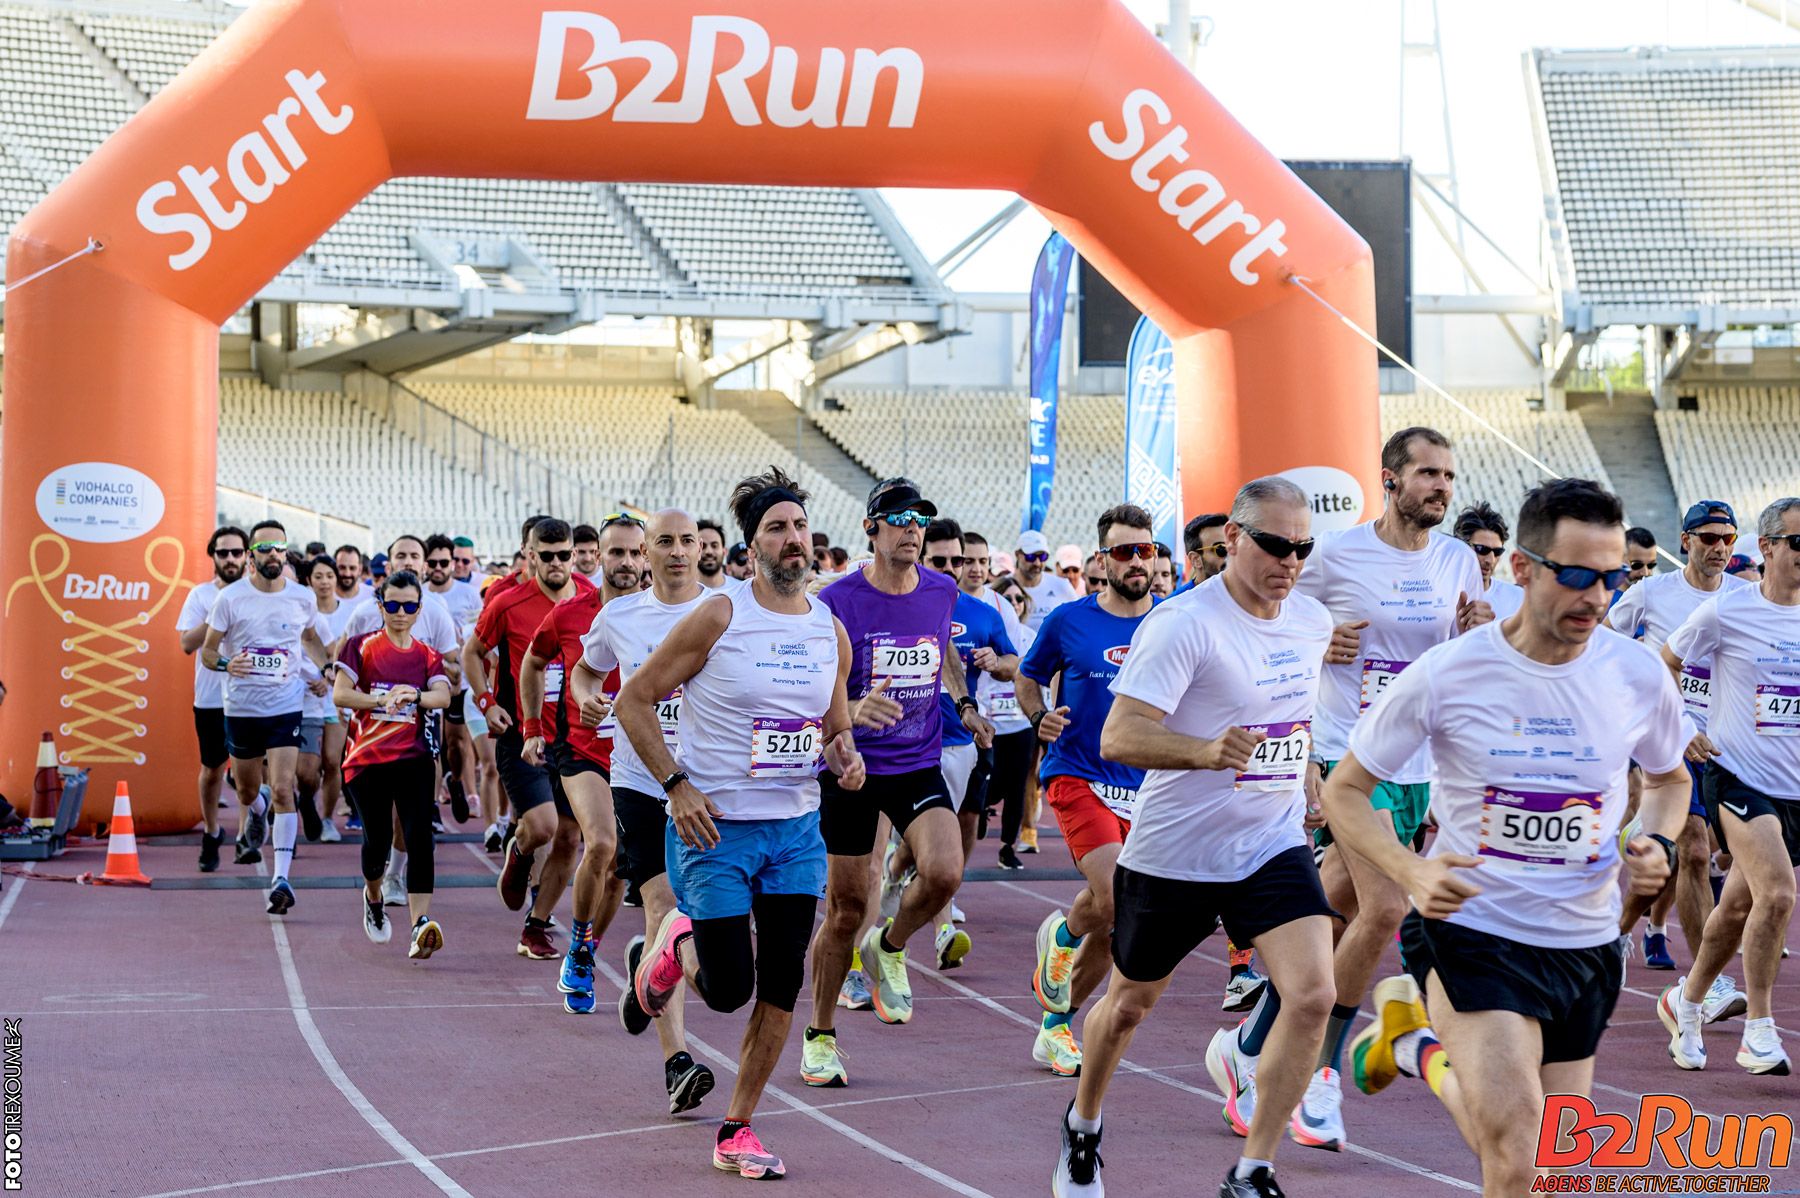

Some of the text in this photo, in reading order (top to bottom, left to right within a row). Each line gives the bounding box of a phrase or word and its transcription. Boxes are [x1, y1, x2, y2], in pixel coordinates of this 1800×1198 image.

[526, 10, 923, 129] B2Run
[135, 68, 354, 271] Start
[1088, 88, 1288, 286] Start
[456, 241, 478, 262] 34
[74, 481, 134, 494] VIOHALCO
[69, 493, 138, 508] COMPANIES
[63, 573, 150, 600] B2Run
[251, 656, 282, 669] 1839
[885, 649, 931, 667] 7033
[772, 677, 796, 686] Running
[1681, 677, 1711, 697] 484
[898, 687, 935, 700] CHAMPS
[998, 700, 1018, 709] 713
[766, 733, 812, 753] 5210
[1255, 739, 1303, 763] 4712
[1101, 783, 1137, 802] 101
[1502, 813, 1583, 842] 5006
